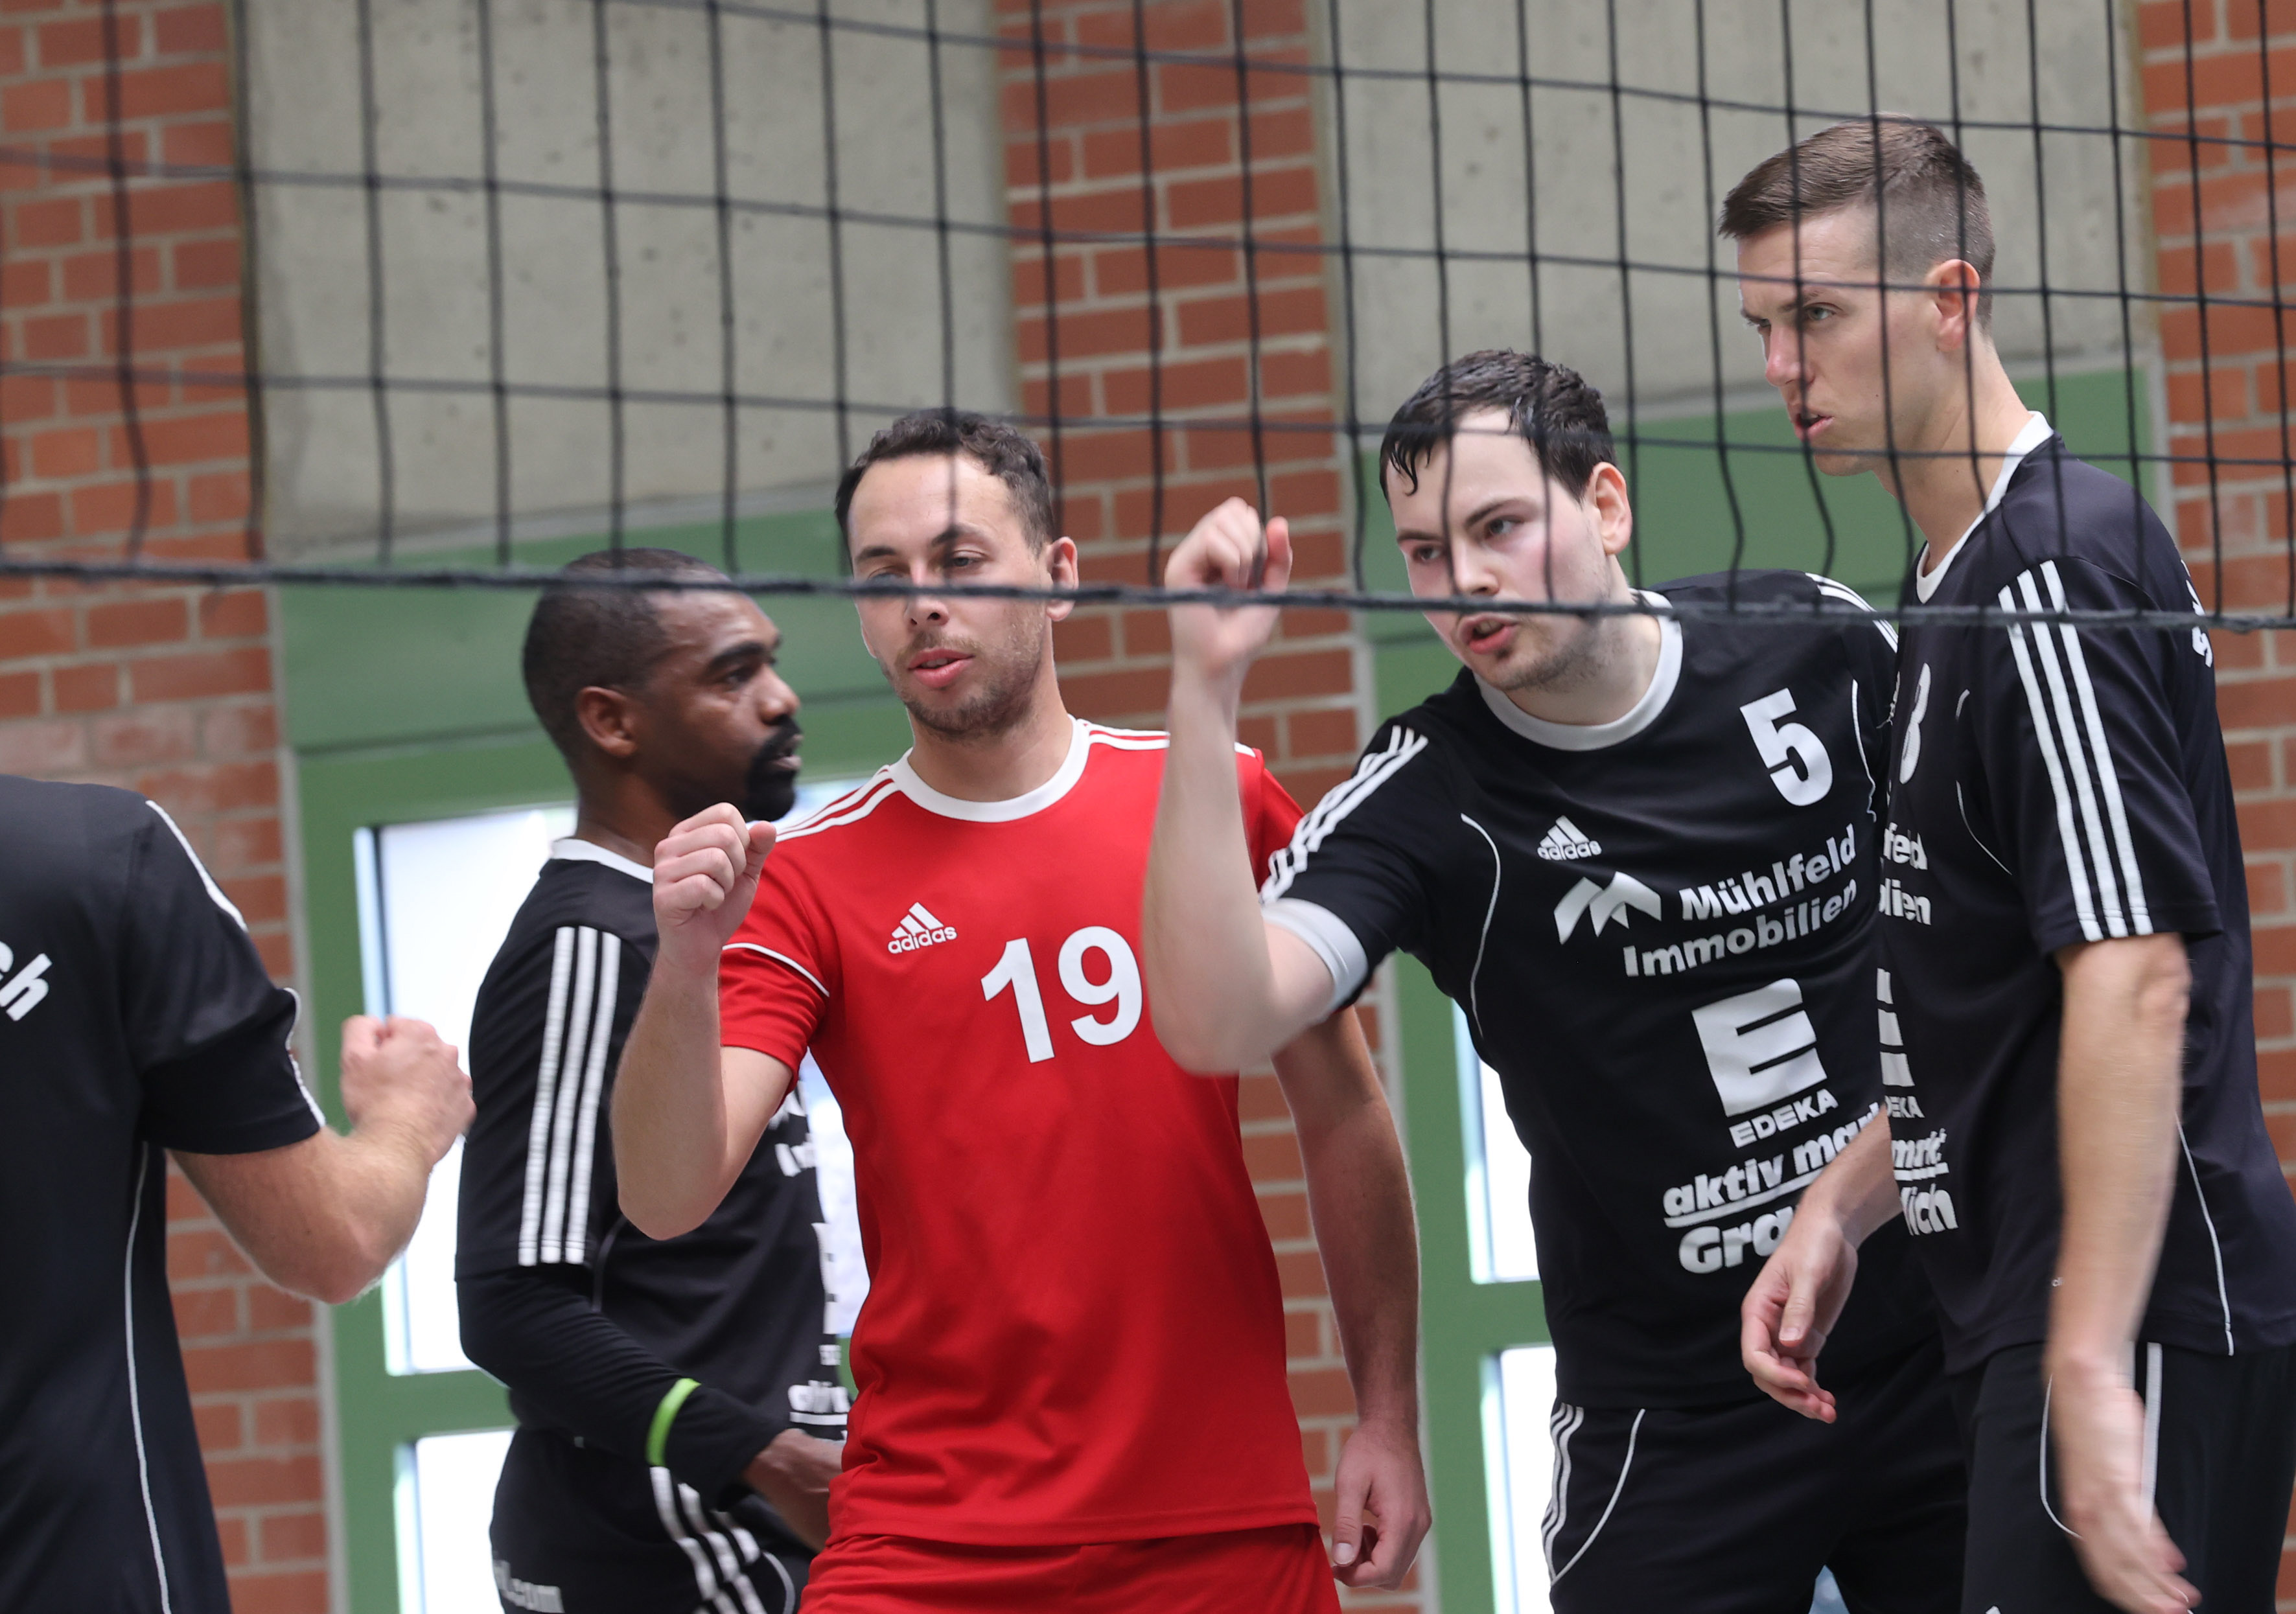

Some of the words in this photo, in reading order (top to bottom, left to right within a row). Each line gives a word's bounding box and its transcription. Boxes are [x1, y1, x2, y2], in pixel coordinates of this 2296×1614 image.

[1739, 687, 1833, 807] 5
[1537, 840, 1602, 861] adidas
[1678, 823, 1856, 921] Mühlfeld
[887, 926, 958, 954] adidas
[1623, 879, 1857, 977] Immobilien
[980, 926, 1143, 1063] 19
[1729, 1089, 1838, 1149] EDEKA
[1663, 1154, 1784, 1217] aktiv
